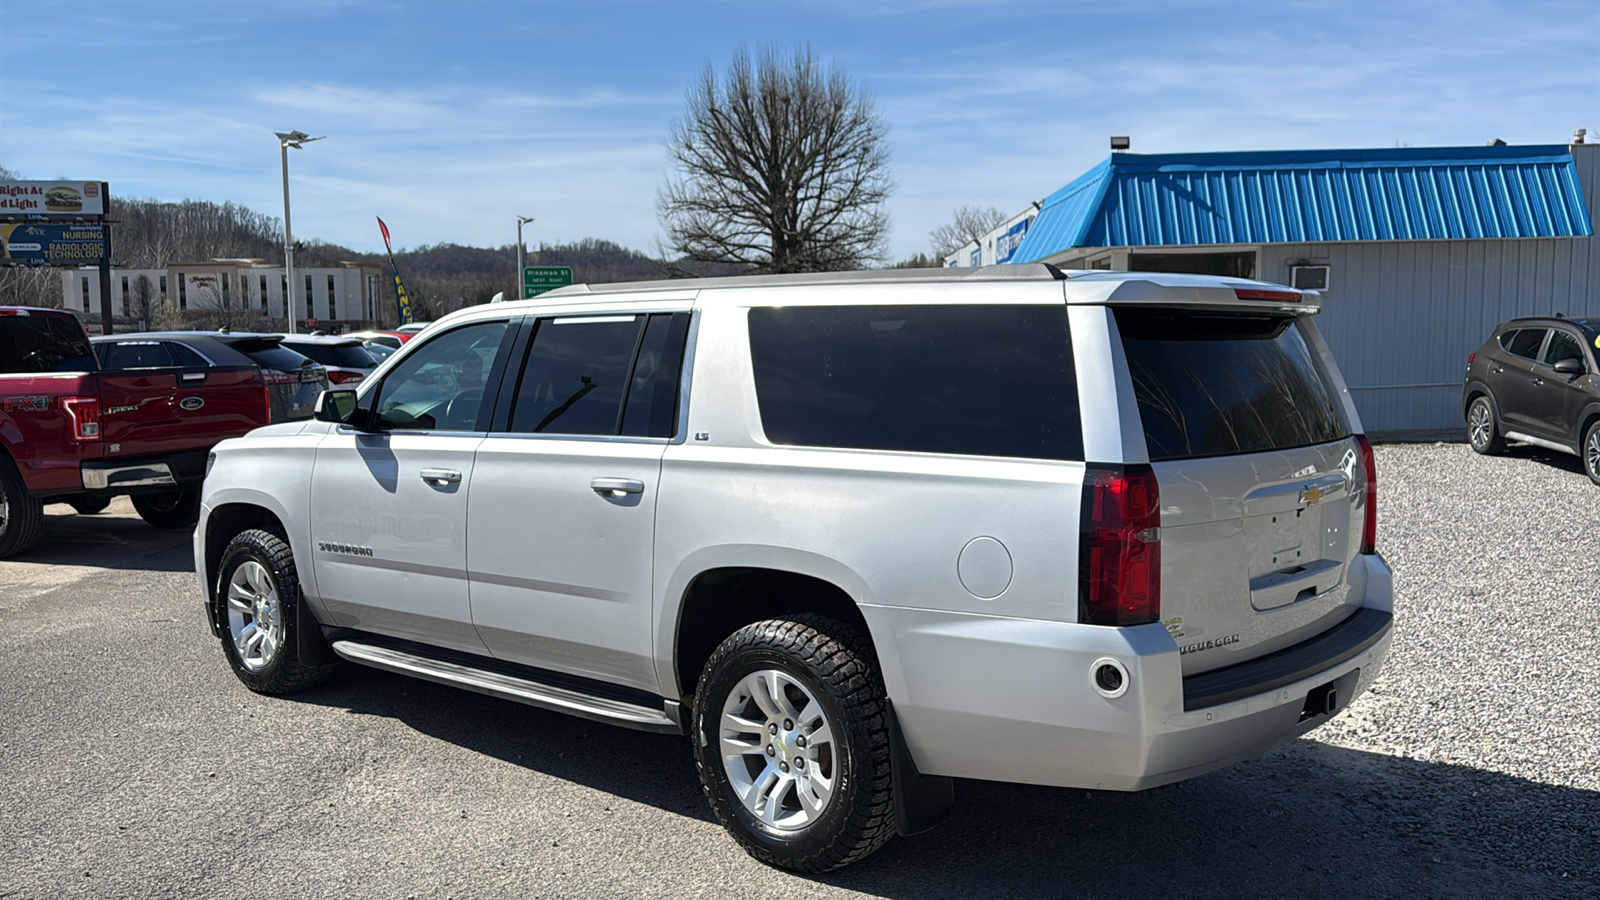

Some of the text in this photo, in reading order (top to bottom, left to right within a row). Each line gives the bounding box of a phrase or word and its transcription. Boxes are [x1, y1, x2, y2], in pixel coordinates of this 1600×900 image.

[30, 186, 43, 195] At
[9, 199, 38, 210] Light
[62, 231, 103, 240] NURSING
[49, 243, 104, 251] RADIOLOGIC
[43, 250, 104, 259] TECHNOLOGY
[4, 396, 49, 412] FX4
[318, 542, 374, 557] SUBURBAN
[1180, 634, 1240, 655] UBURBAN
